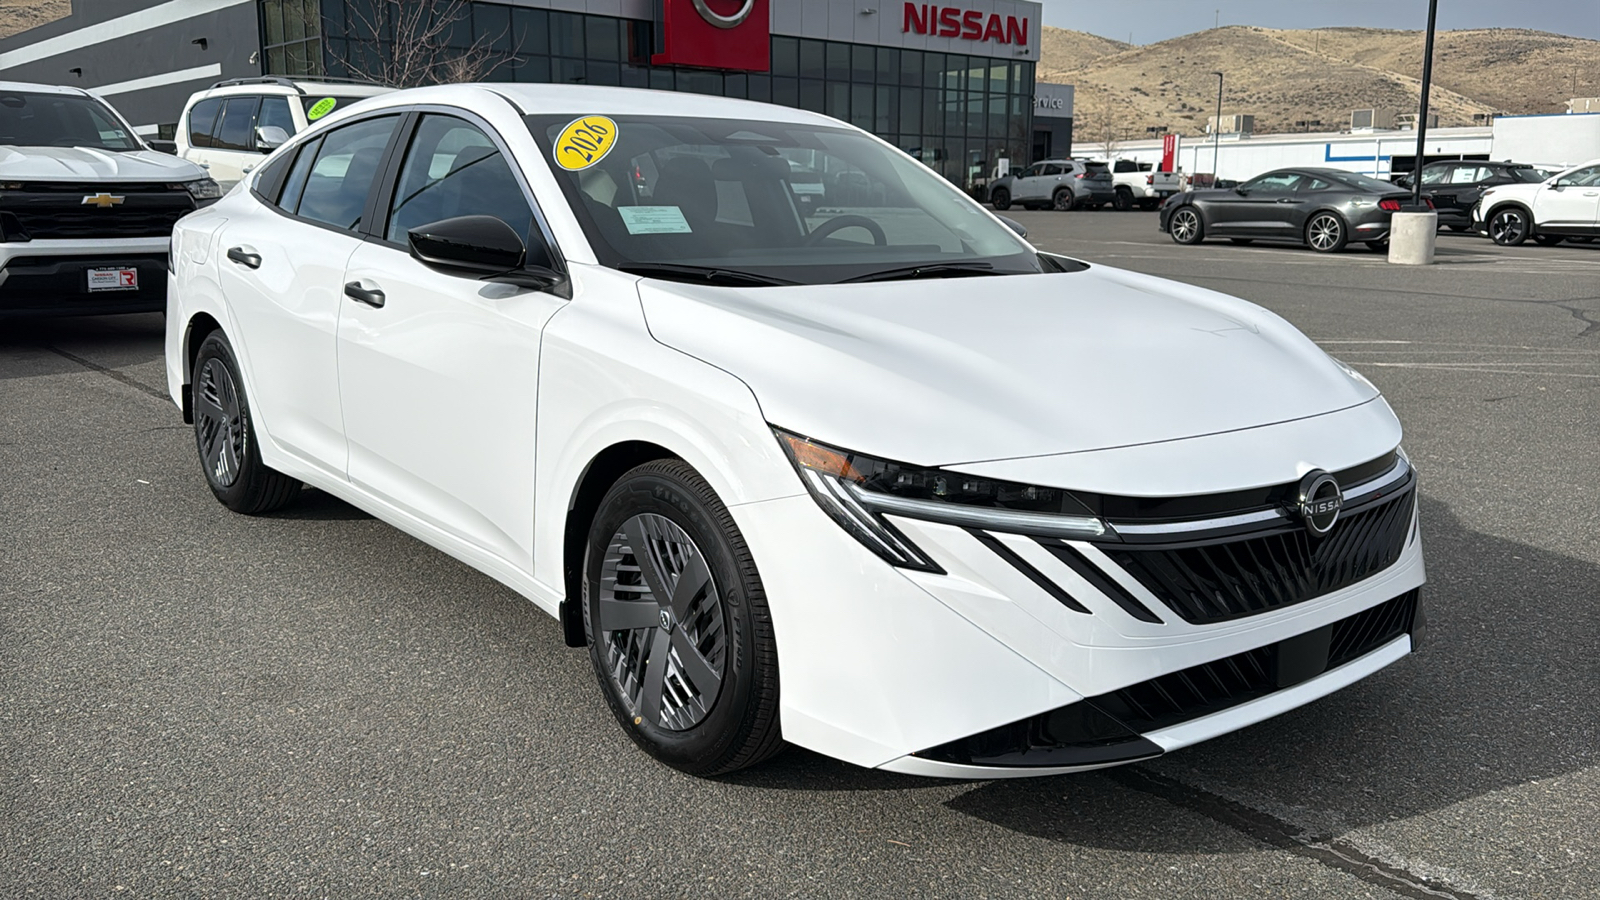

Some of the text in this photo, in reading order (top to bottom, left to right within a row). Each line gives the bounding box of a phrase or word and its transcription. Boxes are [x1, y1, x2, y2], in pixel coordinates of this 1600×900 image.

[904, 2, 1028, 46] NISSAN
[1032, 95, 1063, 109] ervice
[564, 120, 608, 163] 2026
[1304, 499, 1340, 515] NISSA
